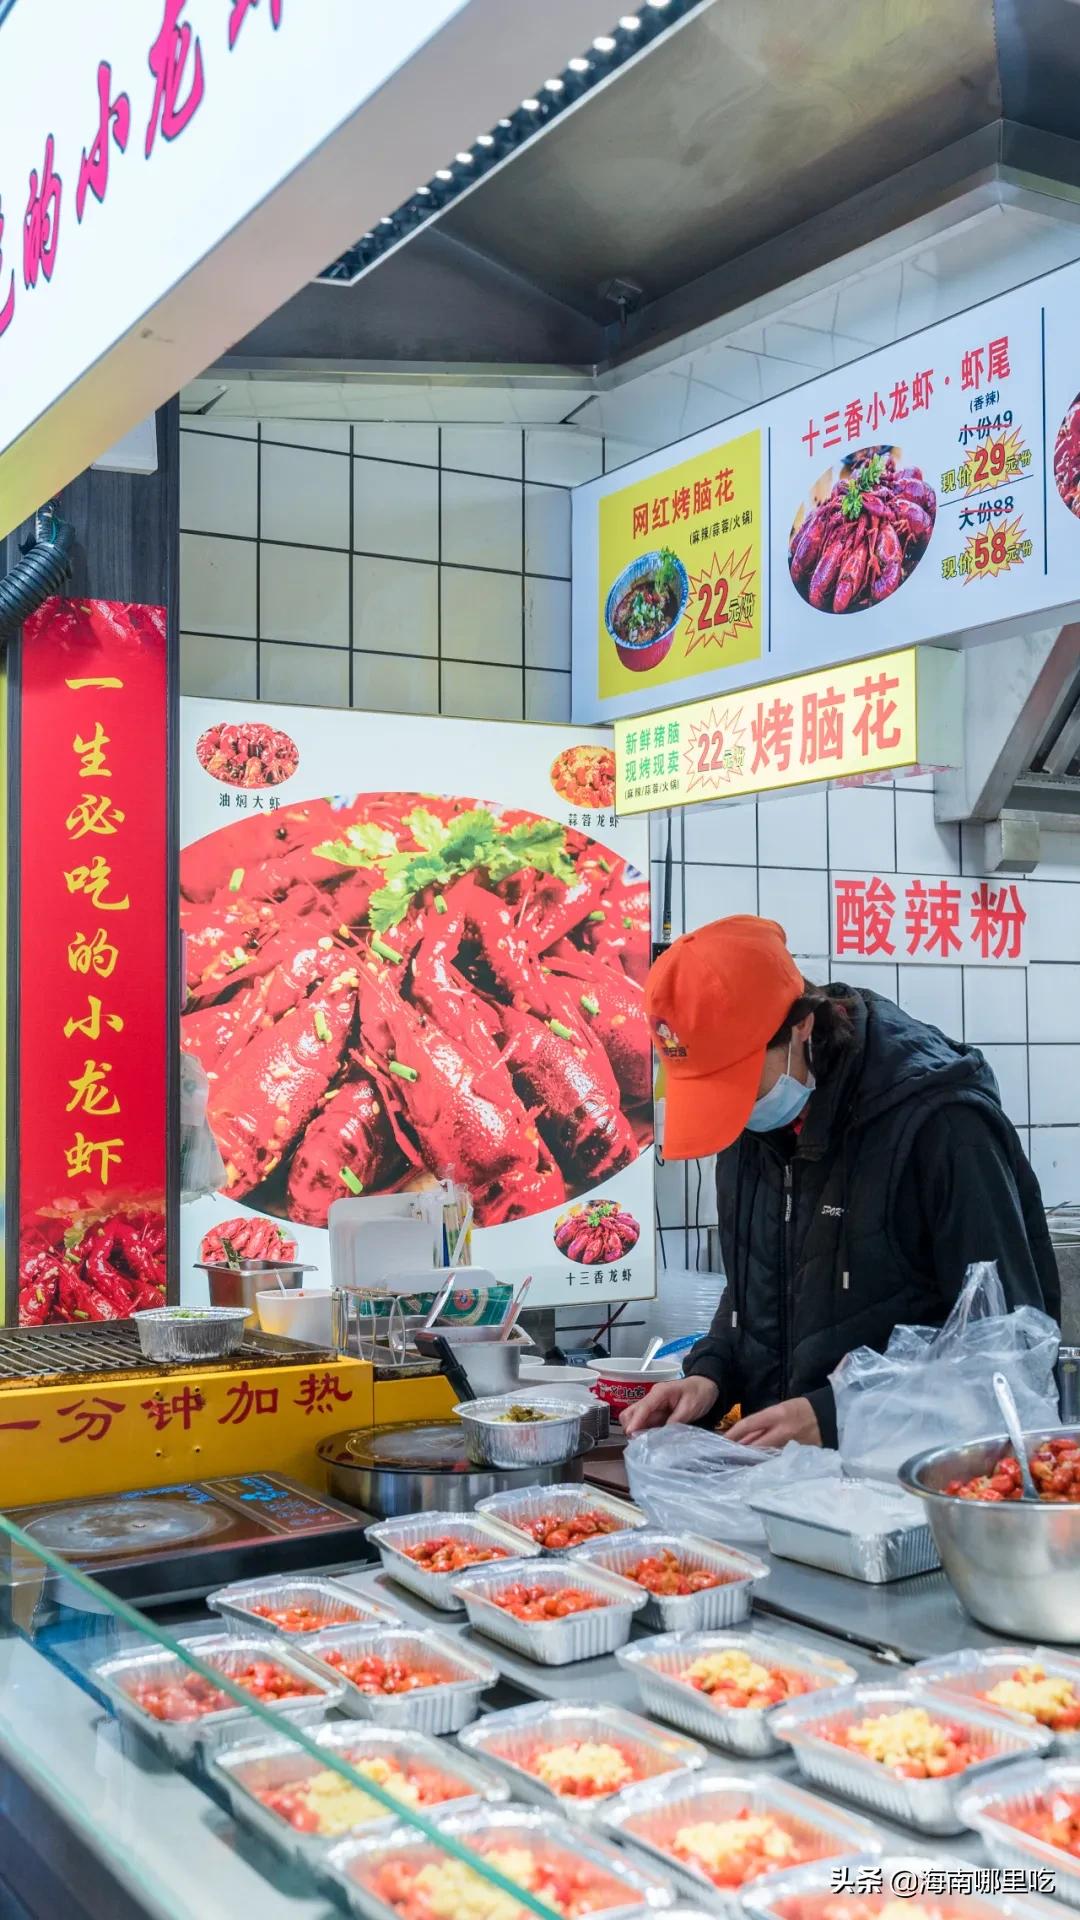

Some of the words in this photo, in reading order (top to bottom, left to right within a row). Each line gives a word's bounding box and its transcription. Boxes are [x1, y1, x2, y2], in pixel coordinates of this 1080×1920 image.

[970, 390, 1000, 413] (香辣)
[958, 410, 1013, 445] 小份49
[633, 467, 734, 539] 网红烤脑花
[958, 495, 1014, 531] 大份88
[625, 721, 680, 755] 新鲜猪脑
[751, 672, 901, 774] 烤脑花
[625, 750, 679, 783] 现烤现卖
[219, 792, 281, 811] 油焖大虾
[63, 676, 130, 1185] 一生必吃的小龙虾
[833, 876, 1028, 959] 酸辣粉
[565, 1268, 632, 1287] 十三香龙虾
